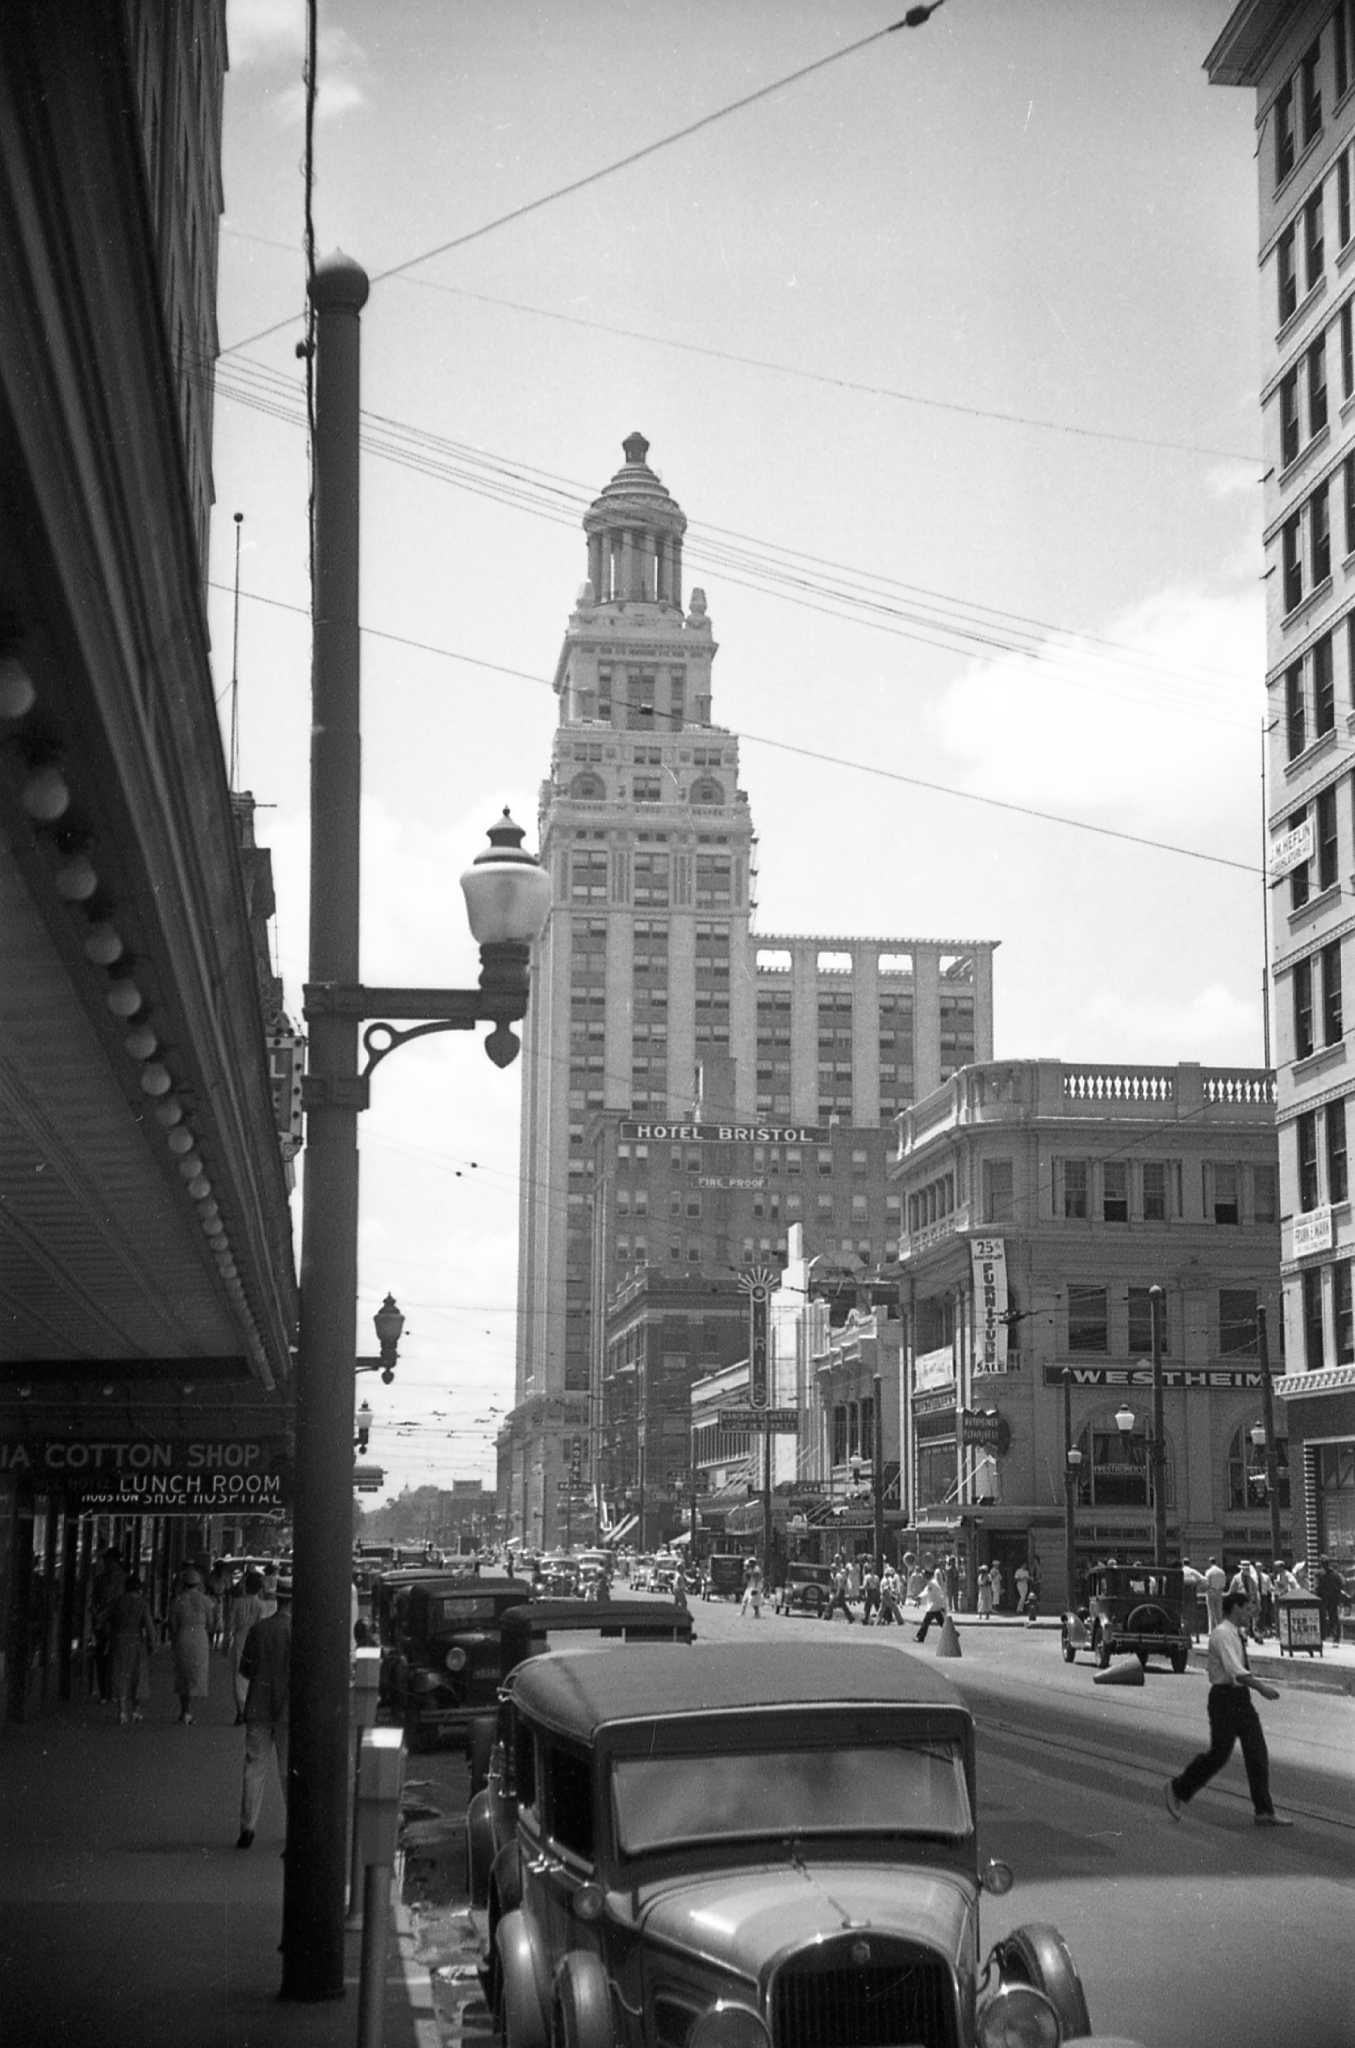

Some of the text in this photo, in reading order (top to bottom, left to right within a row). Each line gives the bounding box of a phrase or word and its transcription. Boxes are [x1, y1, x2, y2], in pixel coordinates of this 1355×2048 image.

[637, 1125, 813, 1142] HOTEL BRISTOL
[983, 1262, 996, 1363] FURNITURE
[754, 1313, 765, 1398] IRIS
[977, 1361, 1005, 1373] SALE
[45, 1444, 172, 1468] COTTON
[187, 1444, 260, 1468] SHOP
[119, 1475, 201, 1493] LUNCH
[212, 1475, 280, 1492] ROOM
